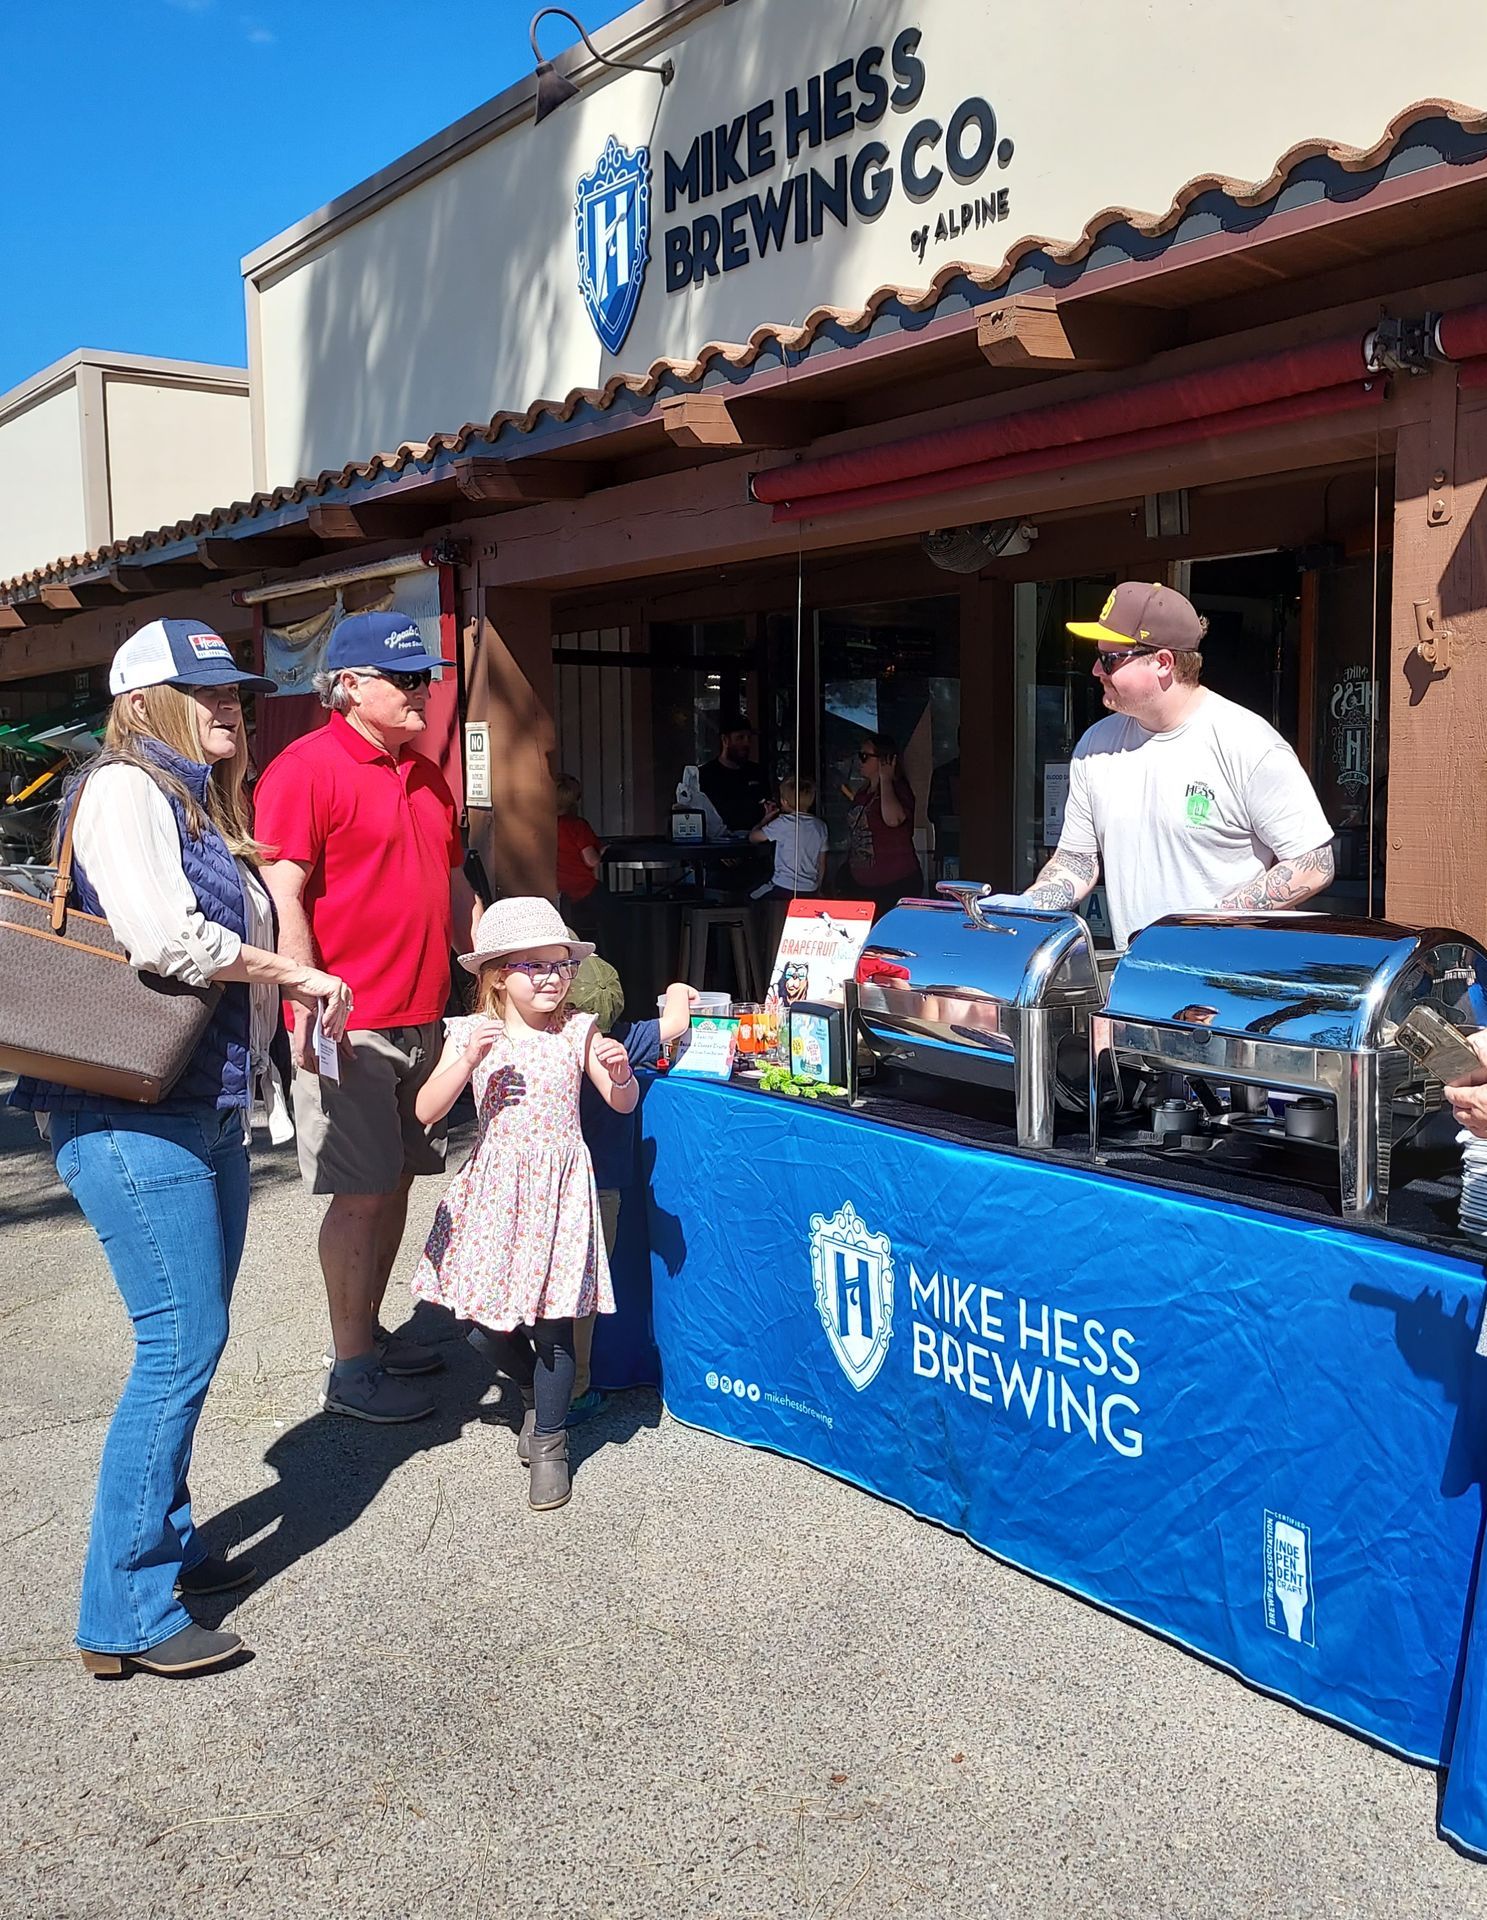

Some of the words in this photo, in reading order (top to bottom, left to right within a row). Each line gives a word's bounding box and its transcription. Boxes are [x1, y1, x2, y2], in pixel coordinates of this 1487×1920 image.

[664, 99, 776, 213] MIKE
[785, 27, 927, 158] HESS
[665, 141, 894, 293] BREWING
[901, 96, 1015, 203] CO.
[911, 225, 930, 265] of
[934, 187, 1010, 245] ALPINE
[471, 734, 483, 751] NO
[1185, 784, 1215, 801] HESS
[1085, 893, 1103, 919] A
[781, 938, 838, 957] GRAPEFRUIT
[909, 1262, 1005, 1343] MIKE
[1019, 1298, 1141, 1385] HESS
[913, 1321, 1144, 1458] BREWING
[764, 1391, 833, 1429] mikehessbrewing
[1274, 1511, 1307, 1529] CERTIFIED
[1266, 1518, 1274, 1580] ASSOCIATION
[1275, 1538, 1300, 1559] INDE
[1275, 1553, 1297, 1571] PEN
[1276, 1567, 1304, 1587] DENT
[1276, 1579, 1303, 1595] CRAFT
[1267, 1580, 1276, 1625] BREWERS
